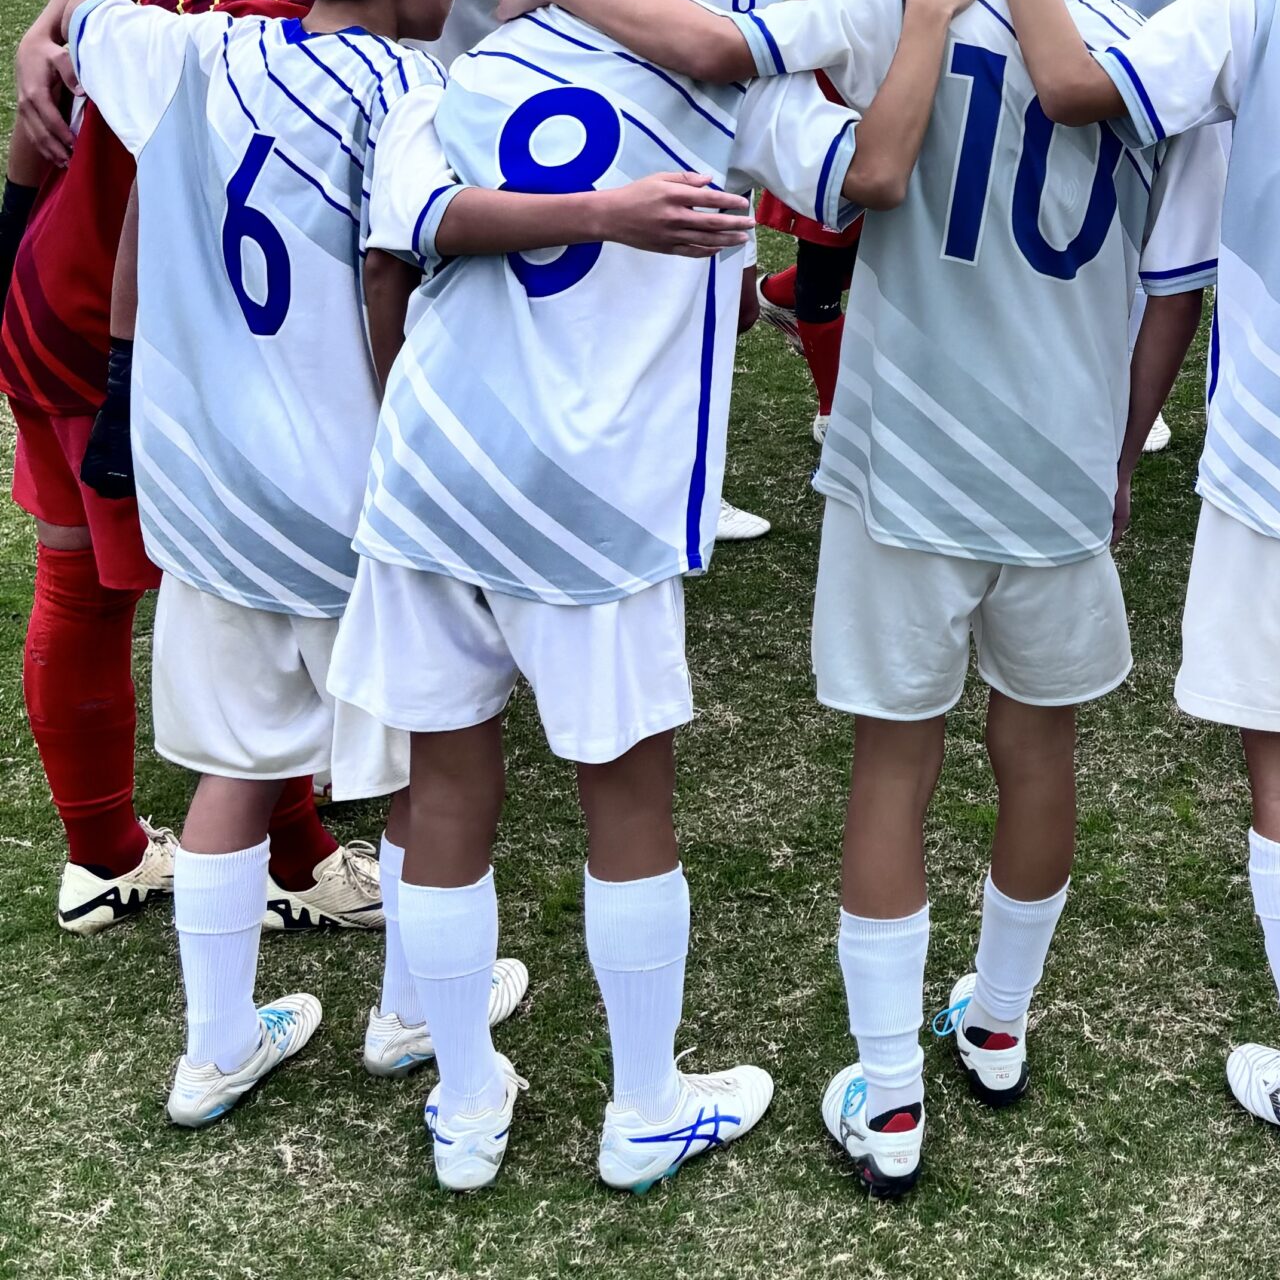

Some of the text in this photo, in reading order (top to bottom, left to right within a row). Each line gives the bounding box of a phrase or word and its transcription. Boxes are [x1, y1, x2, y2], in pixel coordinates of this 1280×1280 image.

[223, 132, 292, 336] 6
[499, 86, 622, 298] 8
[950, 43, 1118, 280] 10
